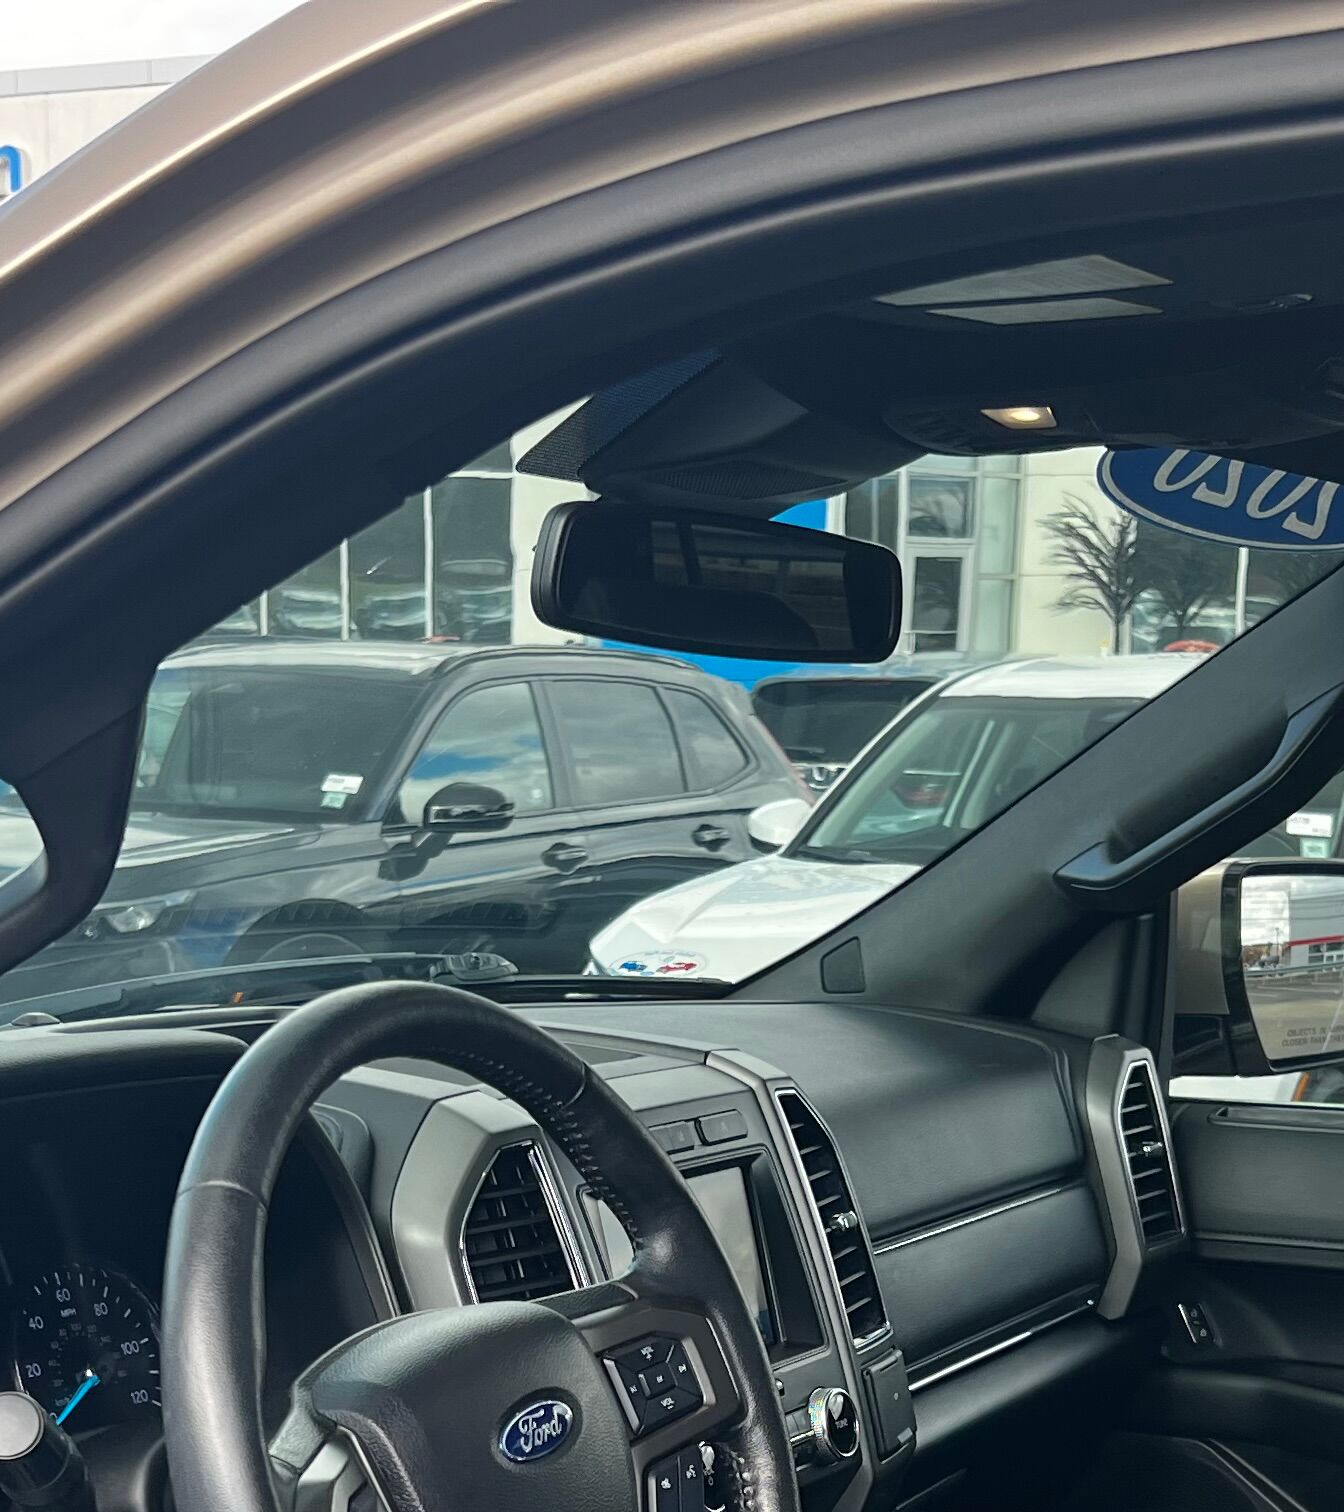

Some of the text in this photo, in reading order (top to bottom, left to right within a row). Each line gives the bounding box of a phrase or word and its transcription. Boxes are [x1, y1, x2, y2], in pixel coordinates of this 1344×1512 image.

[56, 1288, 71, 1302] 60
[94, 1302, 108, 1316] 80
[29, 1315, 44, 1330] 40
[121, 1340, 140, 1356] 100
[25, 1363, 42, 1378] 20
[130, 1389, 149, 1405] 120
[518, 1404, 563, 1453] Ford
